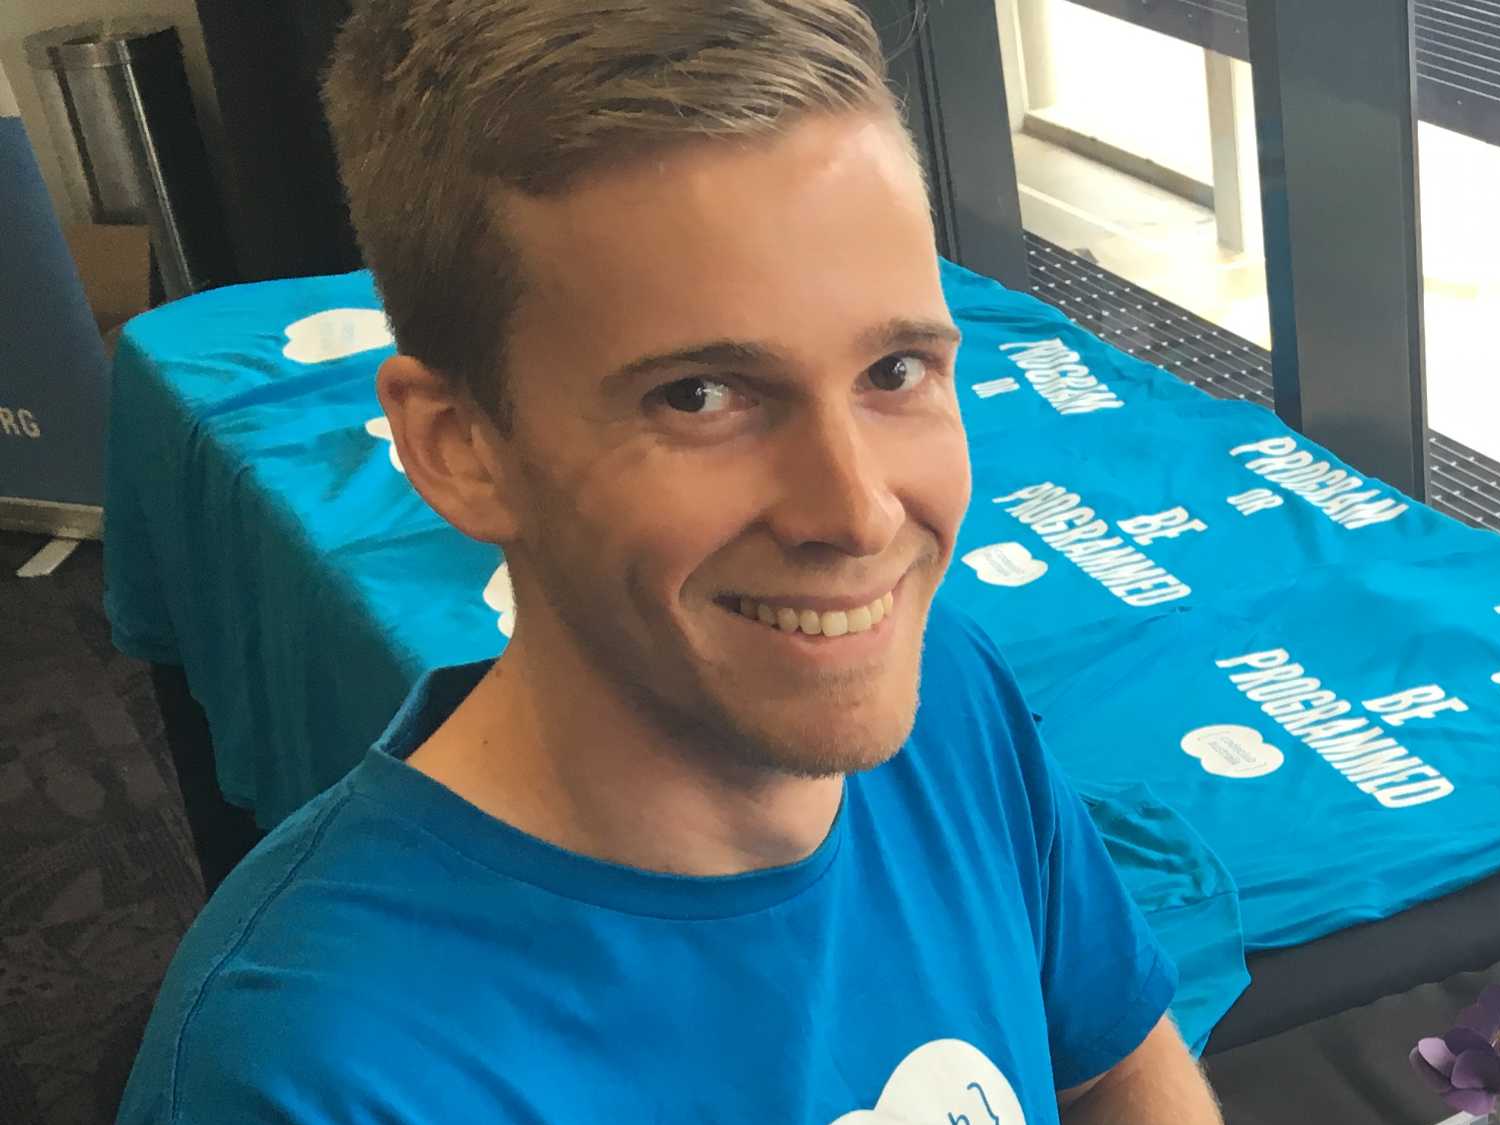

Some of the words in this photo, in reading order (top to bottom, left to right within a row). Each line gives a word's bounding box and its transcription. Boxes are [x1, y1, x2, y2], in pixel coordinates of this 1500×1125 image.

[1226, 488, 1284, 516] OR
[1229, 436, 1409, 530] PROGRAM
[992, 481, 1192, 606] PROGRAMMED
[1116, 506, 1208, 545] BE
[1215, 648, 1455, 808] PROGRAMMED
[1361, 684, 1469, 726] BE
